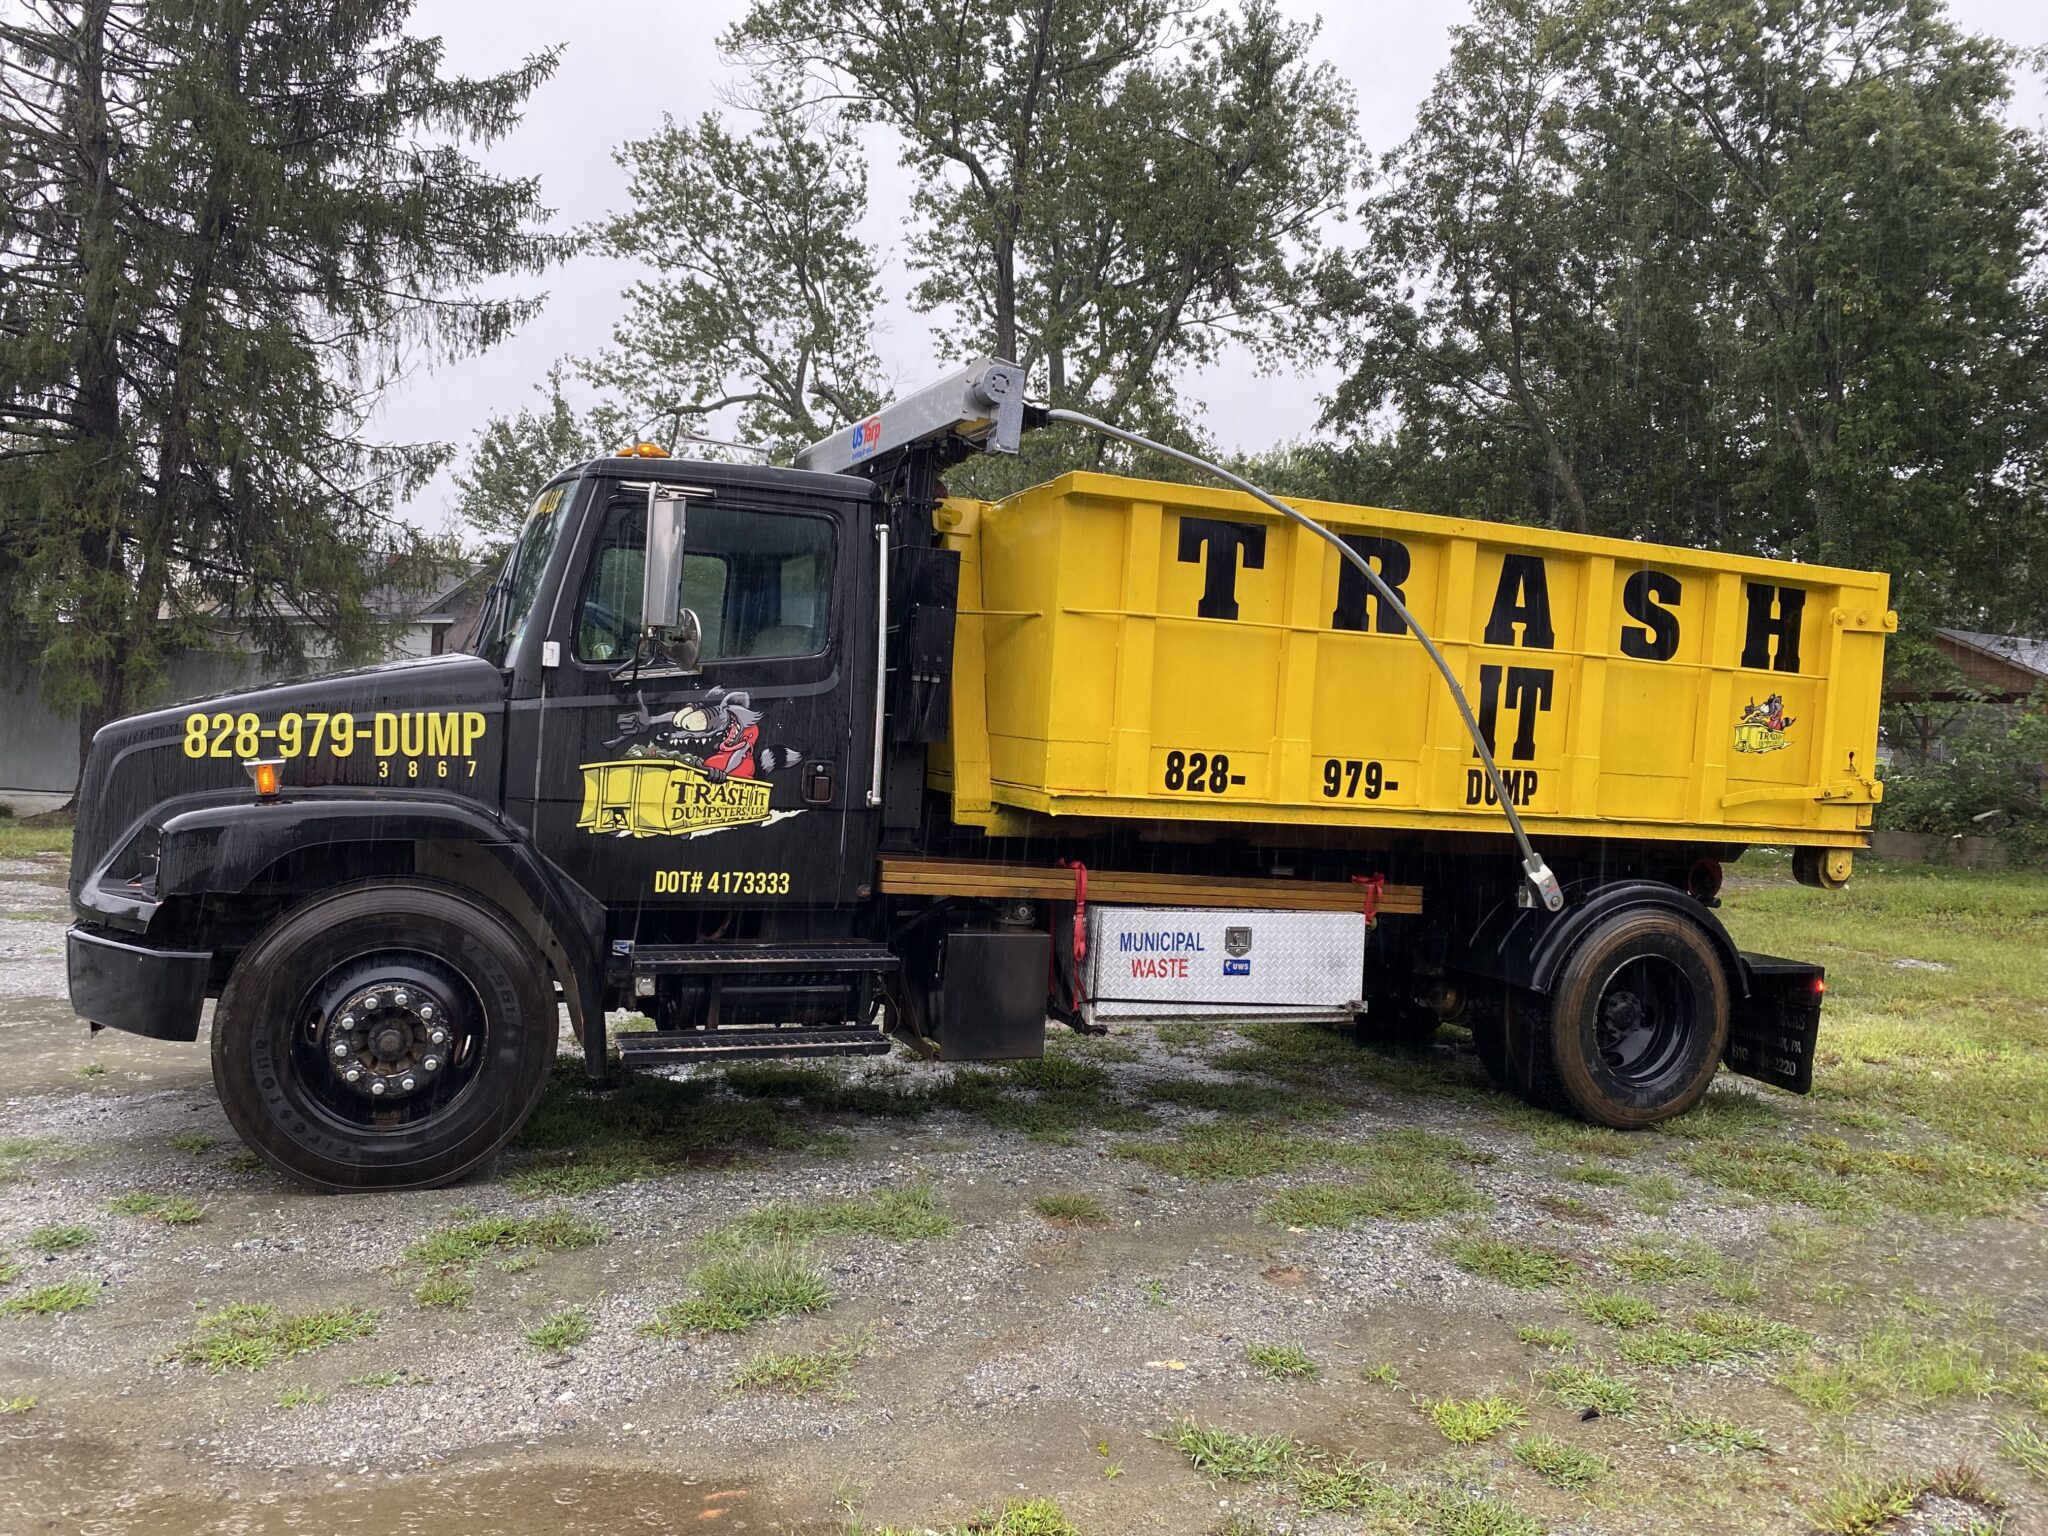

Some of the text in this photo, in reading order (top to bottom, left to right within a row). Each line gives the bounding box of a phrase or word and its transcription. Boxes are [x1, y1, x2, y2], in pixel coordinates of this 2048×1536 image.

[852, 425, 864, 449] US
[1177, 516, 1807, 674] TRASH
[1472, 664, 1555, 761] IT
[183, 712, 486, 758] 828-979-DUMP
[1164, 750, 1538, 806] 828- 979- DUMP
[671, 781, 767, 806] TRASH IT
[751, 808, 765, 816] LLC
[654, 871, 790, 894] DOT# 4173333
[1119, 932, 1205, 952] MUNICIPAL
[1131, 958, 1189, 978] WASTE
